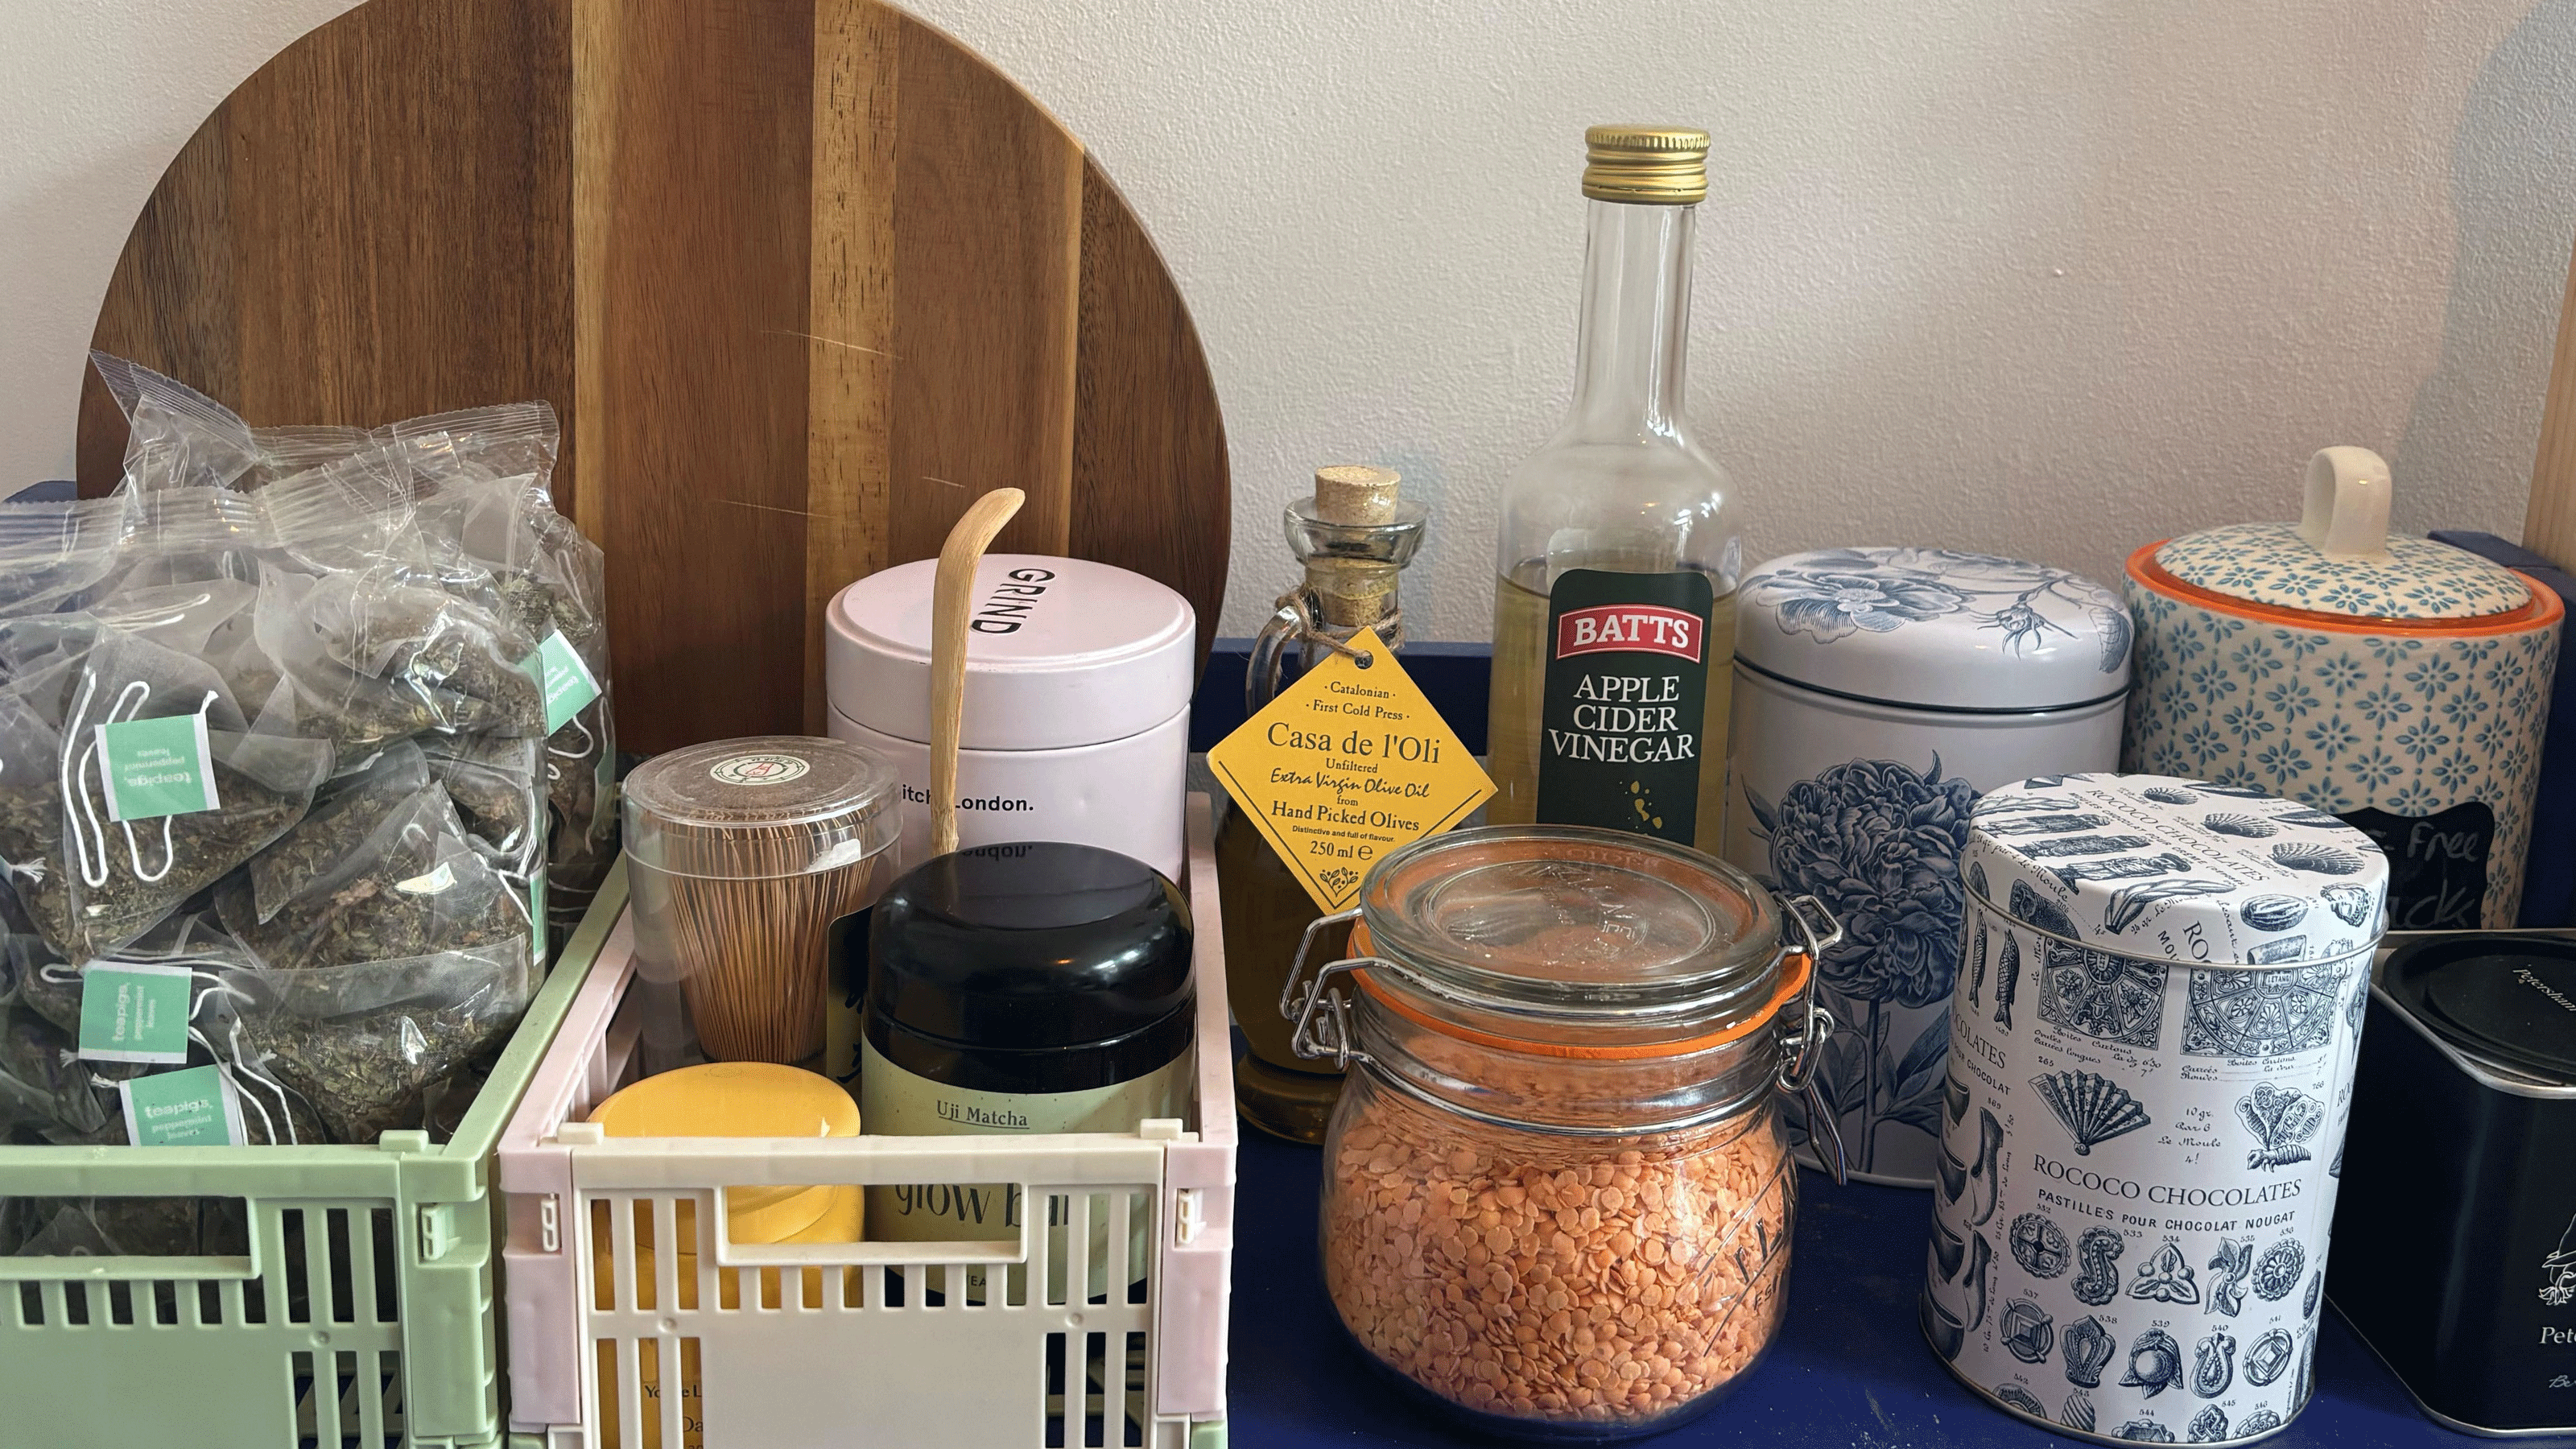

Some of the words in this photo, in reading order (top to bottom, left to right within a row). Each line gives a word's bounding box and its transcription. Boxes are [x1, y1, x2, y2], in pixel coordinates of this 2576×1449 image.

[971, 568, 1055, 634] GRIND
[1573, 614, 1689, 649] BATTS
[1330, 681, 1390, 699] Catalonian
[1573, 674, 1680, 703] APPLE
[1313, 700, 1339, 714] First
[1343, 703, 1370, 716] Cold
[1375, 706, 1403, 720] Press
[1573, 704, 1679, 733] CIDER
[1267, 722, 1331, 752] Casa
[1342, 731, 1373, 756] de
[1383, 733, 1441, 764] l'Oli
[1548, 729, 1695, 763] VINEGAR
[1326, 758, 1378, 774] Unfiltered
[1270, 767, 1312, 786] Extra
[1316, 771, 1362, 795] Virgin
[1364, 778, 1402, 795] Olive
[1405, 782, 1430, 799] Oil
[1337, 795, 1359, 807] from
[1271, 801, 1313, 820] Hand
[1317, 805, 1366, 825] Picked
[1370, 811, 1419, 832] Olives
[1292, 825, 1331, 836] Distinctive
[1331, 830, 1346, 838] and
[1347, 831, 1359, 839] full
[1368, 832, 1395, 843] flavour.
[2086, 789, 2159, 824] ROCOCO
[2155, 825, 2270, 881] CHOCOLATES
[2407, 821, 2479, 861] Free
[1310, 840, 1335, 857] 250
[1337, 844, 1353, 858] ml
[2157, 930, 2179, 961] MO
[2182, 920, 2212, 963] RO
[1967, 1059, 2011, 1096] CHOCOLAT
[936, 1100, 959, 1120] Uji
[967, 1107, 1028, 1126] Matcha
[2178, 1137, 2221, 1147] Moule
[2033, 1154, 2140, 1199] ROCOCO
[2148, 1179, 2301, 1206] CHOCOLATES
[2038, 1188, 2115, 1221] PASTILLES
[2122, 1214, 2157, 1228] POUR
[2165, 1220, 2237, 1232] CHOCOLAT
[2246, 1211, 2295, 1229] NOUGAT
[2123, 1228, 2143, 1239] 533
[2161, 1234, 2181, 1243] 534
[2240, 1234, 2256, 1243] 535
[2022, 1288, 2038, 1299] 537
[2099, 1314, 2118, 1324] 538
[2151, 1319, 2171, 1328] 539
[2211, 1323, 2229, 1332] 540
[2139, 1409, 2156, 1417] 544
[2221, 1399, 2236, 1408] 545
